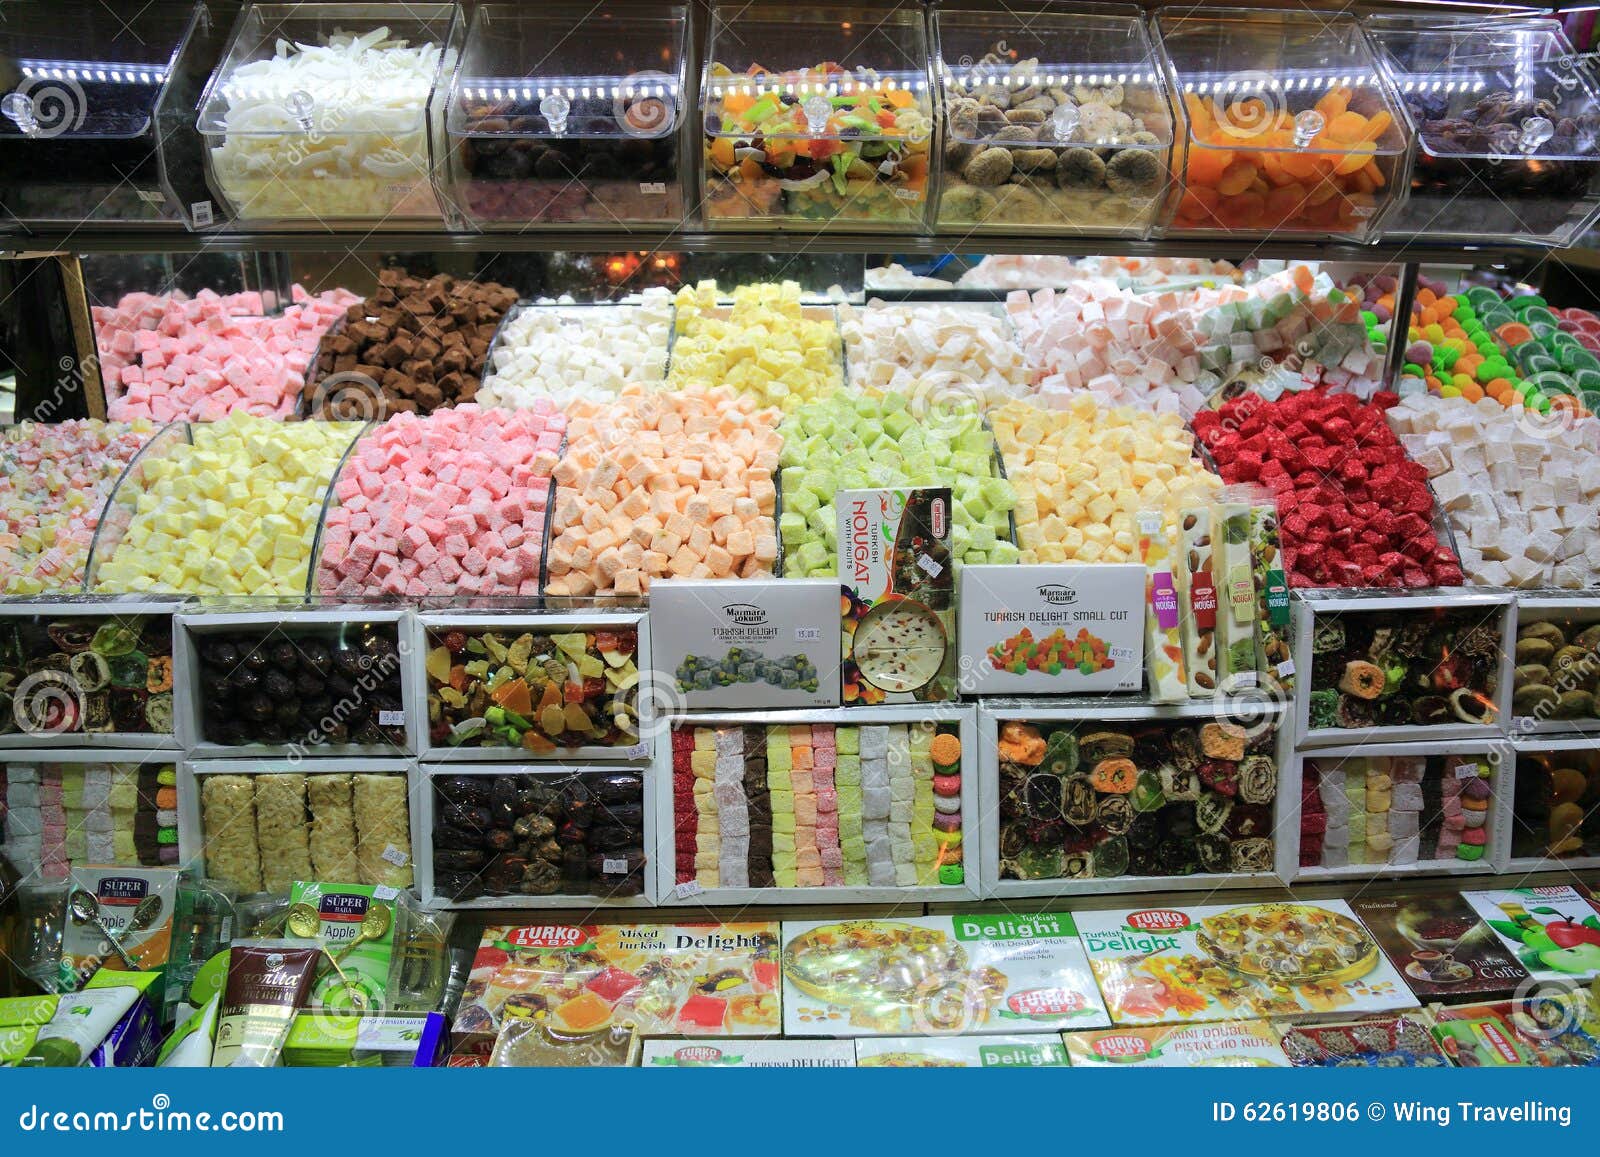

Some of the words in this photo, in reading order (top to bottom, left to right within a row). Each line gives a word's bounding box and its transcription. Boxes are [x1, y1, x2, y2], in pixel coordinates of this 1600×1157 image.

[852, 500, 870, 585] NOUGAT
[871, 522, 879, 563] TURKISH
[1039, 588, 1076, 596] Marmara
[1194, 599, 1216, 610] NOUGAT
[1232, 593, 1254, 604] NOUGAT
[1268, 597, 1289, 608] NOUGAT
[1155, 600, 1177, 611] NOUGAT
[726, 607, 766, 617] Marmara
[984, 611, 1025, 622] TURKISH
[1029, 611, 1069, 622] DELIGHT
[1073, 611, 1106, 621] SMALL
[1110, 610, 1129, 621] CUT
[712, 627, 745, 636] TURKISH
[747, 627, 779, 636] DELIGHT
[105, 879, 142, 891] SÜPER
[326, 894, 363, 908] SÜPER
[101, 914, 126, 929] pple
[1021, 914, 1057, 922] Turkish
[1132, 911, 1184, 923] TURKO
[962, 921, 1060, 938] Delight
[1137, 921, 1184, 929] BABA
[324, 925, 356, 939] Apple
[517, 926, 581, 940] TURKO
[619, 929, 659, 938] Mixed
[1082, 930, 1124, 938] Turkish
[515, 938, 576, 946] BABA
[617, 941, 666, 950] Turkish
[676, 934, 761, 951] Delight
[1086, 935, 1182, 954] Delight
[1480, 965, 1525, 979] Coffe
[1015, 987, 1078, 1006] TURKO
[1169, 1028, 1199, 1041] MINI
[1203, 1025, 1252, 1039] DOUBLE
[1097, 1036, 1146, 1050] TURKO
[1174, 1039, 1237, 1052] PISTACHIO
[1242, 1036, 1273, 1048] NUTS
[679, 1047, 718, 1057] TURKO
